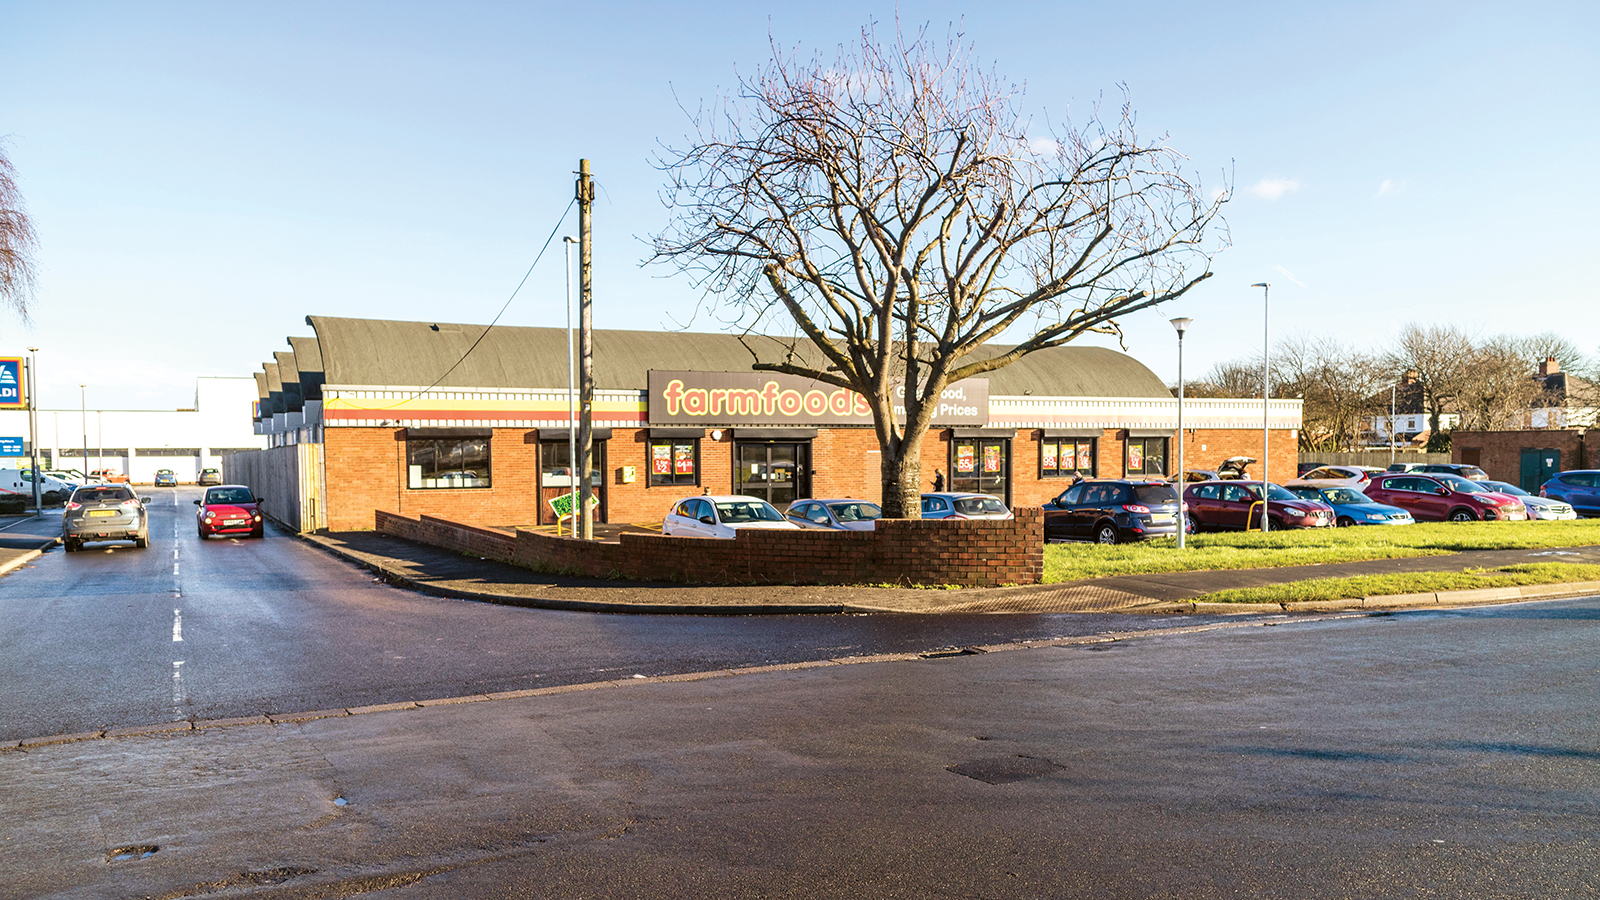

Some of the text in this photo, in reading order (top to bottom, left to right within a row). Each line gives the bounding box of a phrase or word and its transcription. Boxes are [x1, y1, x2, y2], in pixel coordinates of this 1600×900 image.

[0, 388, 17, 397] DI
[663, 380, 873, 416] farmfoods
[941, 387, 967, 401] ood,
[940, 403, 978, 416] Prices
[959, 459, 973, 470] 55p
[1043, 456, 1057, 468] 99p
[657, 464, 667, 473] £2
